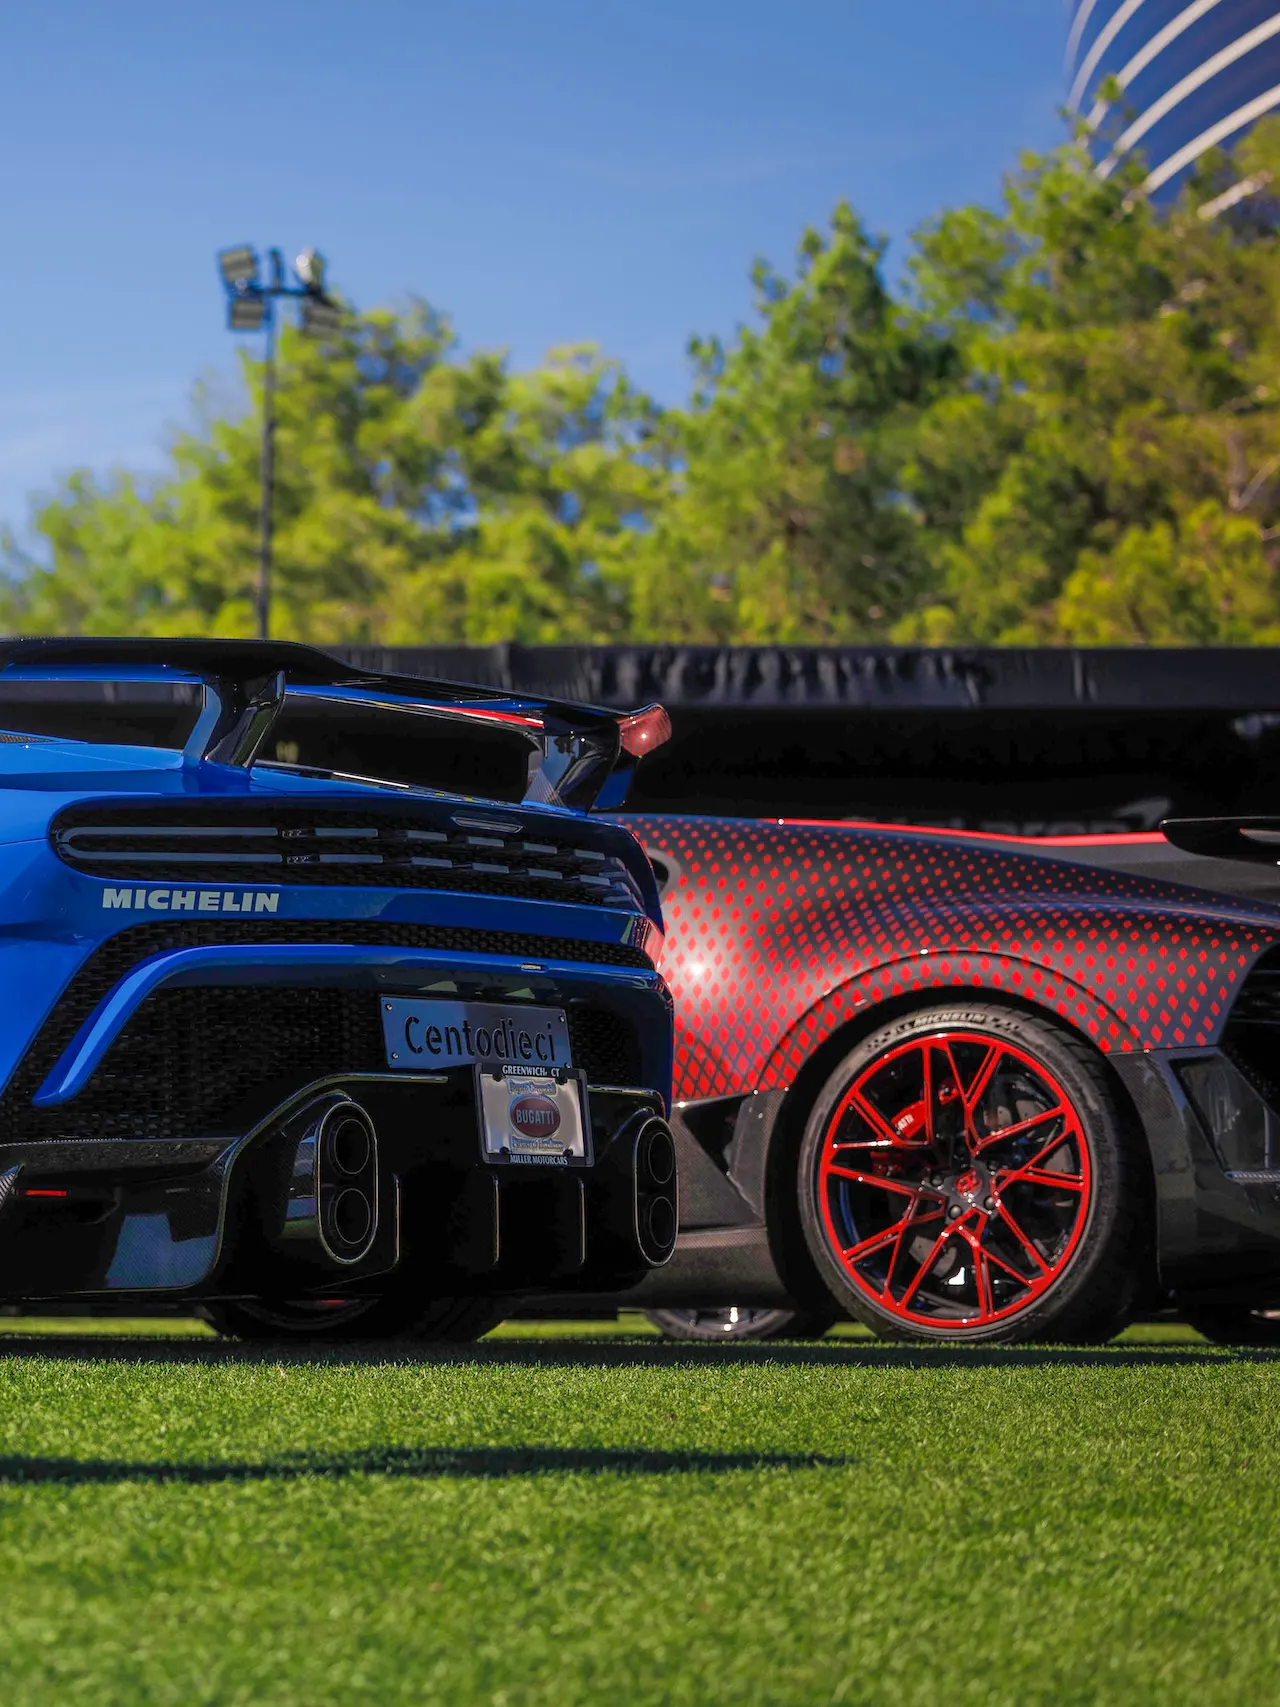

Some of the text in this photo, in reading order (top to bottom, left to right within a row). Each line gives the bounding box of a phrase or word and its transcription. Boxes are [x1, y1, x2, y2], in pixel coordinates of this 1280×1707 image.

[102, 888, 280, 912] MICHELIN
[405, 1016, 556, 1062] Centodieci
[551, 1068, 560, 1077] CT
[516, 1109, 554, 1125] BUGATTI
[510, 1154, 568, 1165] MILLER MOTORCARS
